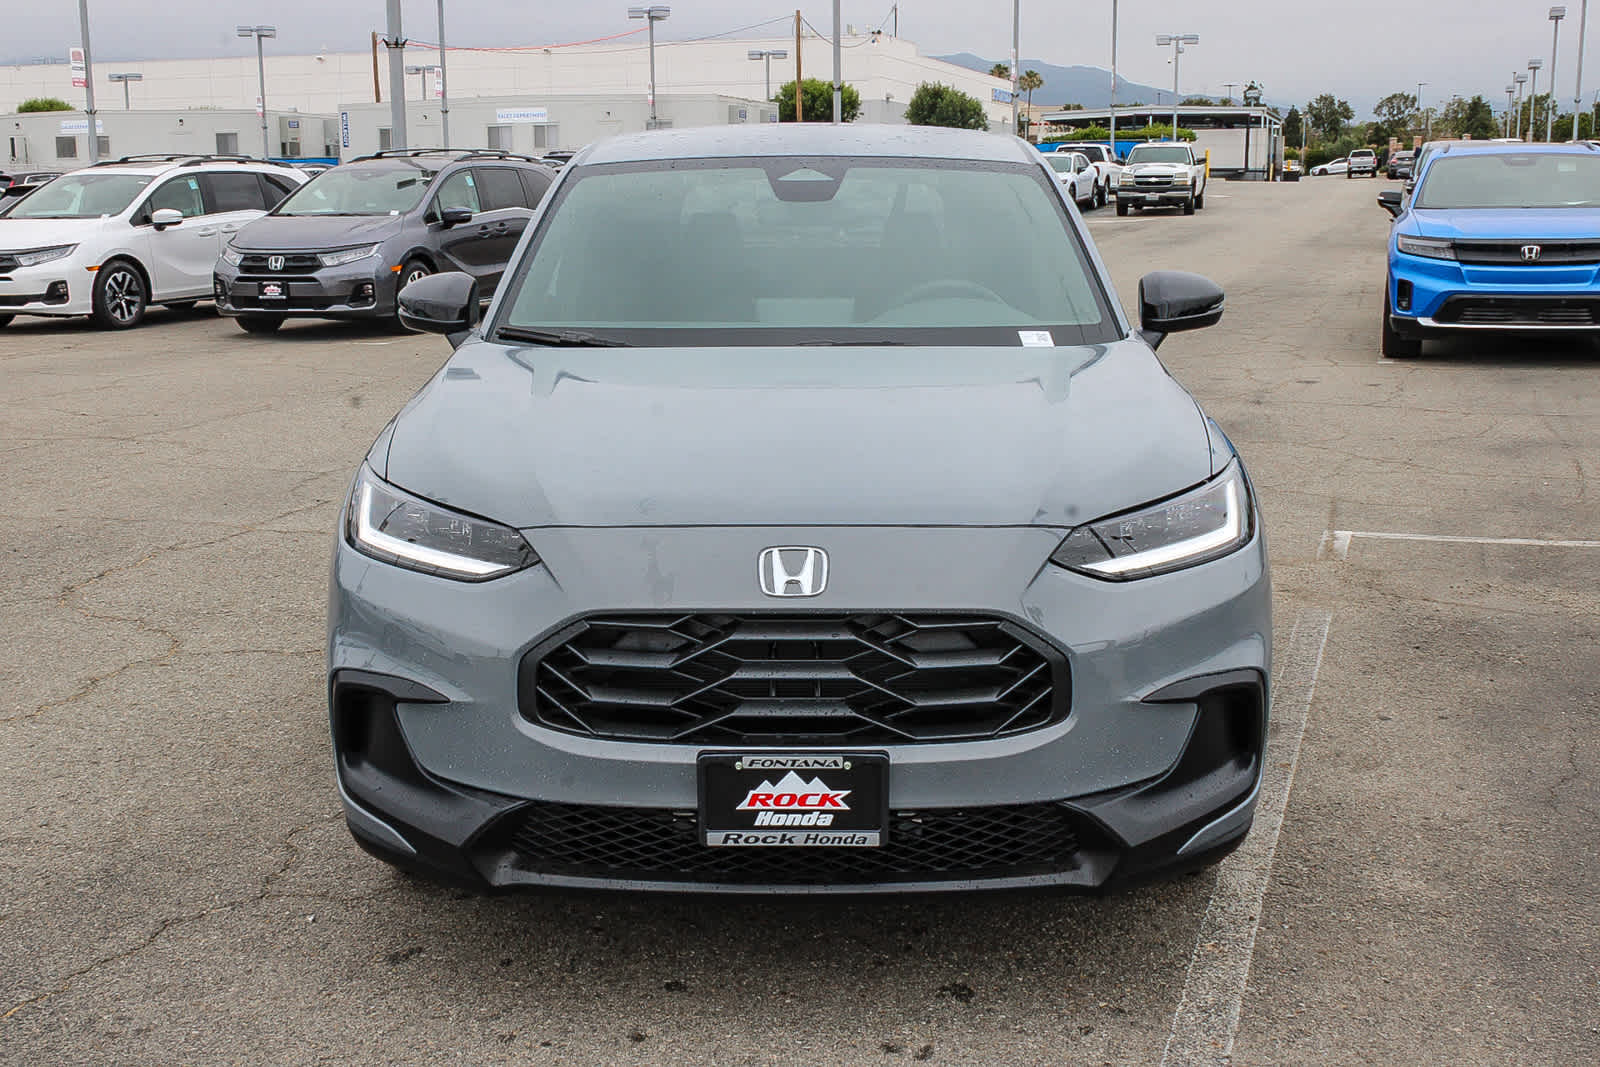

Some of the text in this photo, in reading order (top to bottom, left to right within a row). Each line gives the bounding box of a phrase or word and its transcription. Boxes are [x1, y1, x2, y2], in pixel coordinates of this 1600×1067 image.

[748, 759, 840, 768] FONTANA
[747, 793, 842, 807] ROCK
[754, 811, 834, 826] Honda
[722, 833, 868, 845] Rock Honda
